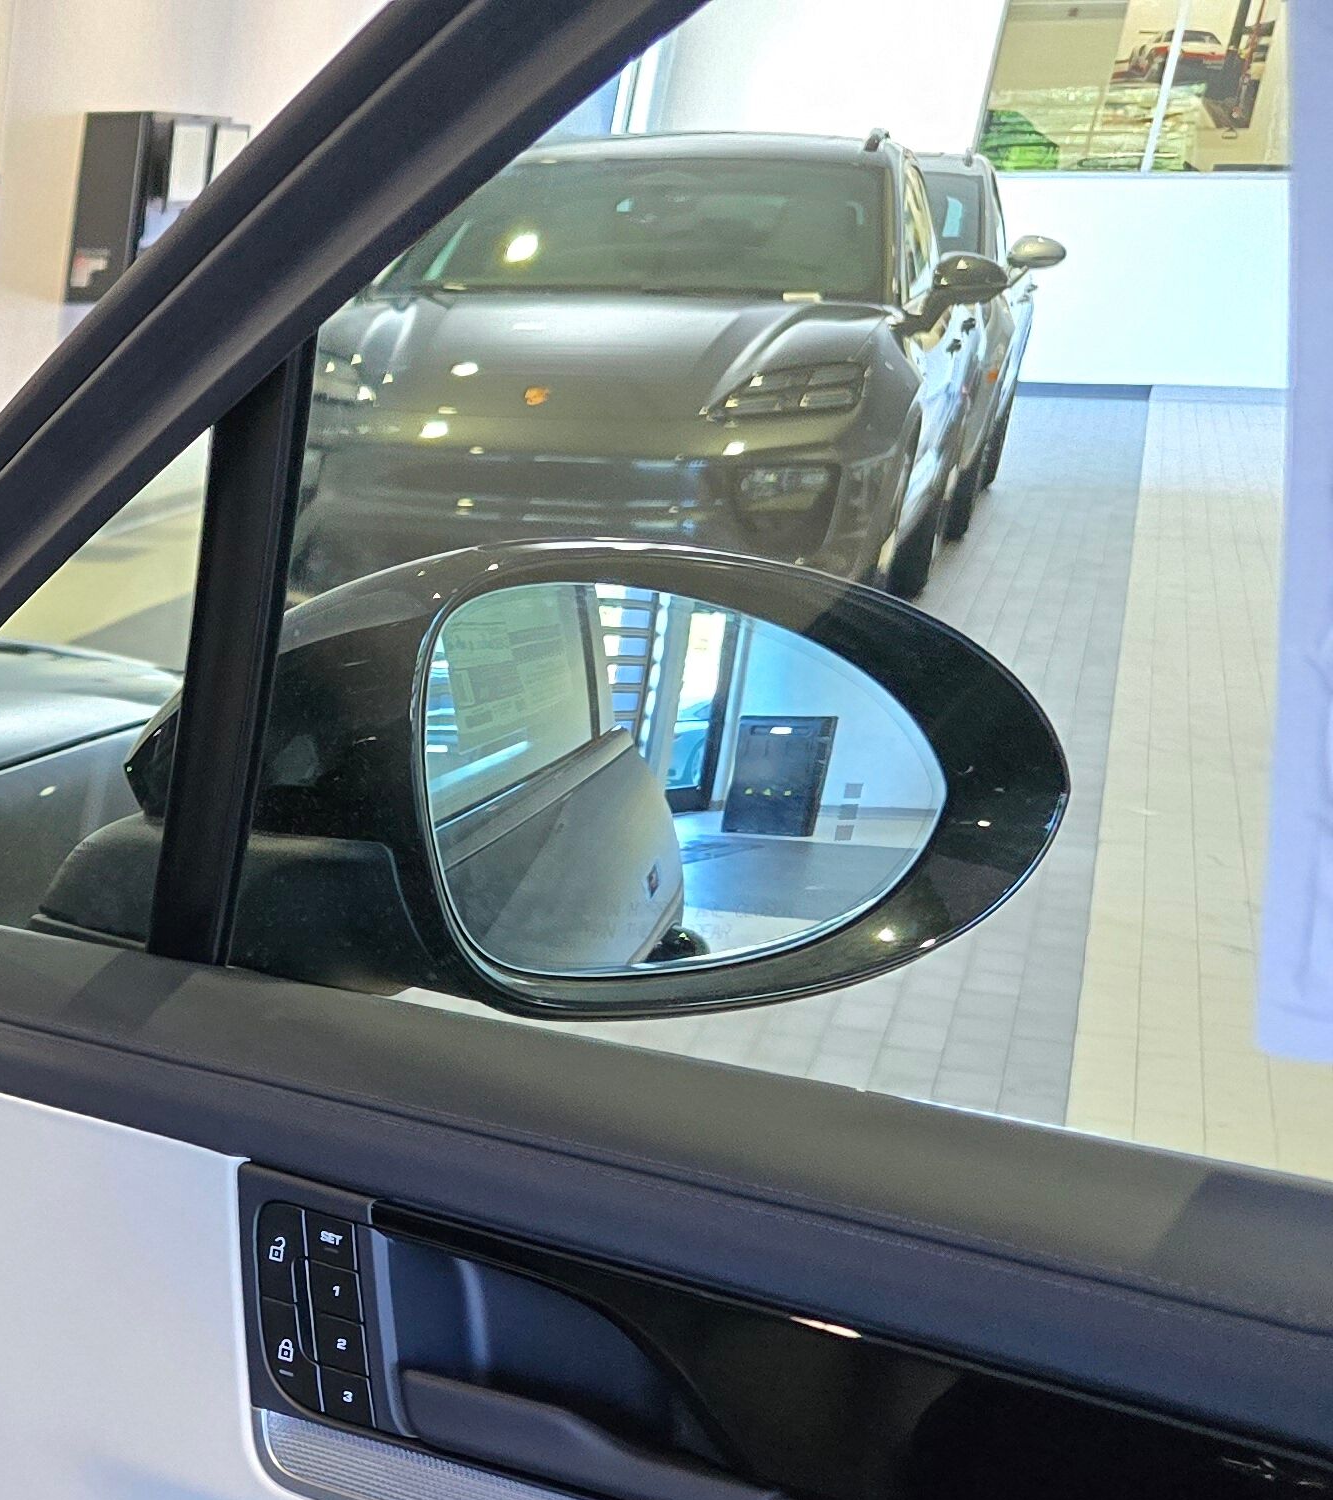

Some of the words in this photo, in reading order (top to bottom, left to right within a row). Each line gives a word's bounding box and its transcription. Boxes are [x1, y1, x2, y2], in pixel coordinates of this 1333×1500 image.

[319, 1229, 343, 1246] SET
[332, 1285, 341, 1297] 1
[336, 1338, 347, 1350] 2
[342, 1390, 353, 1403] 3
